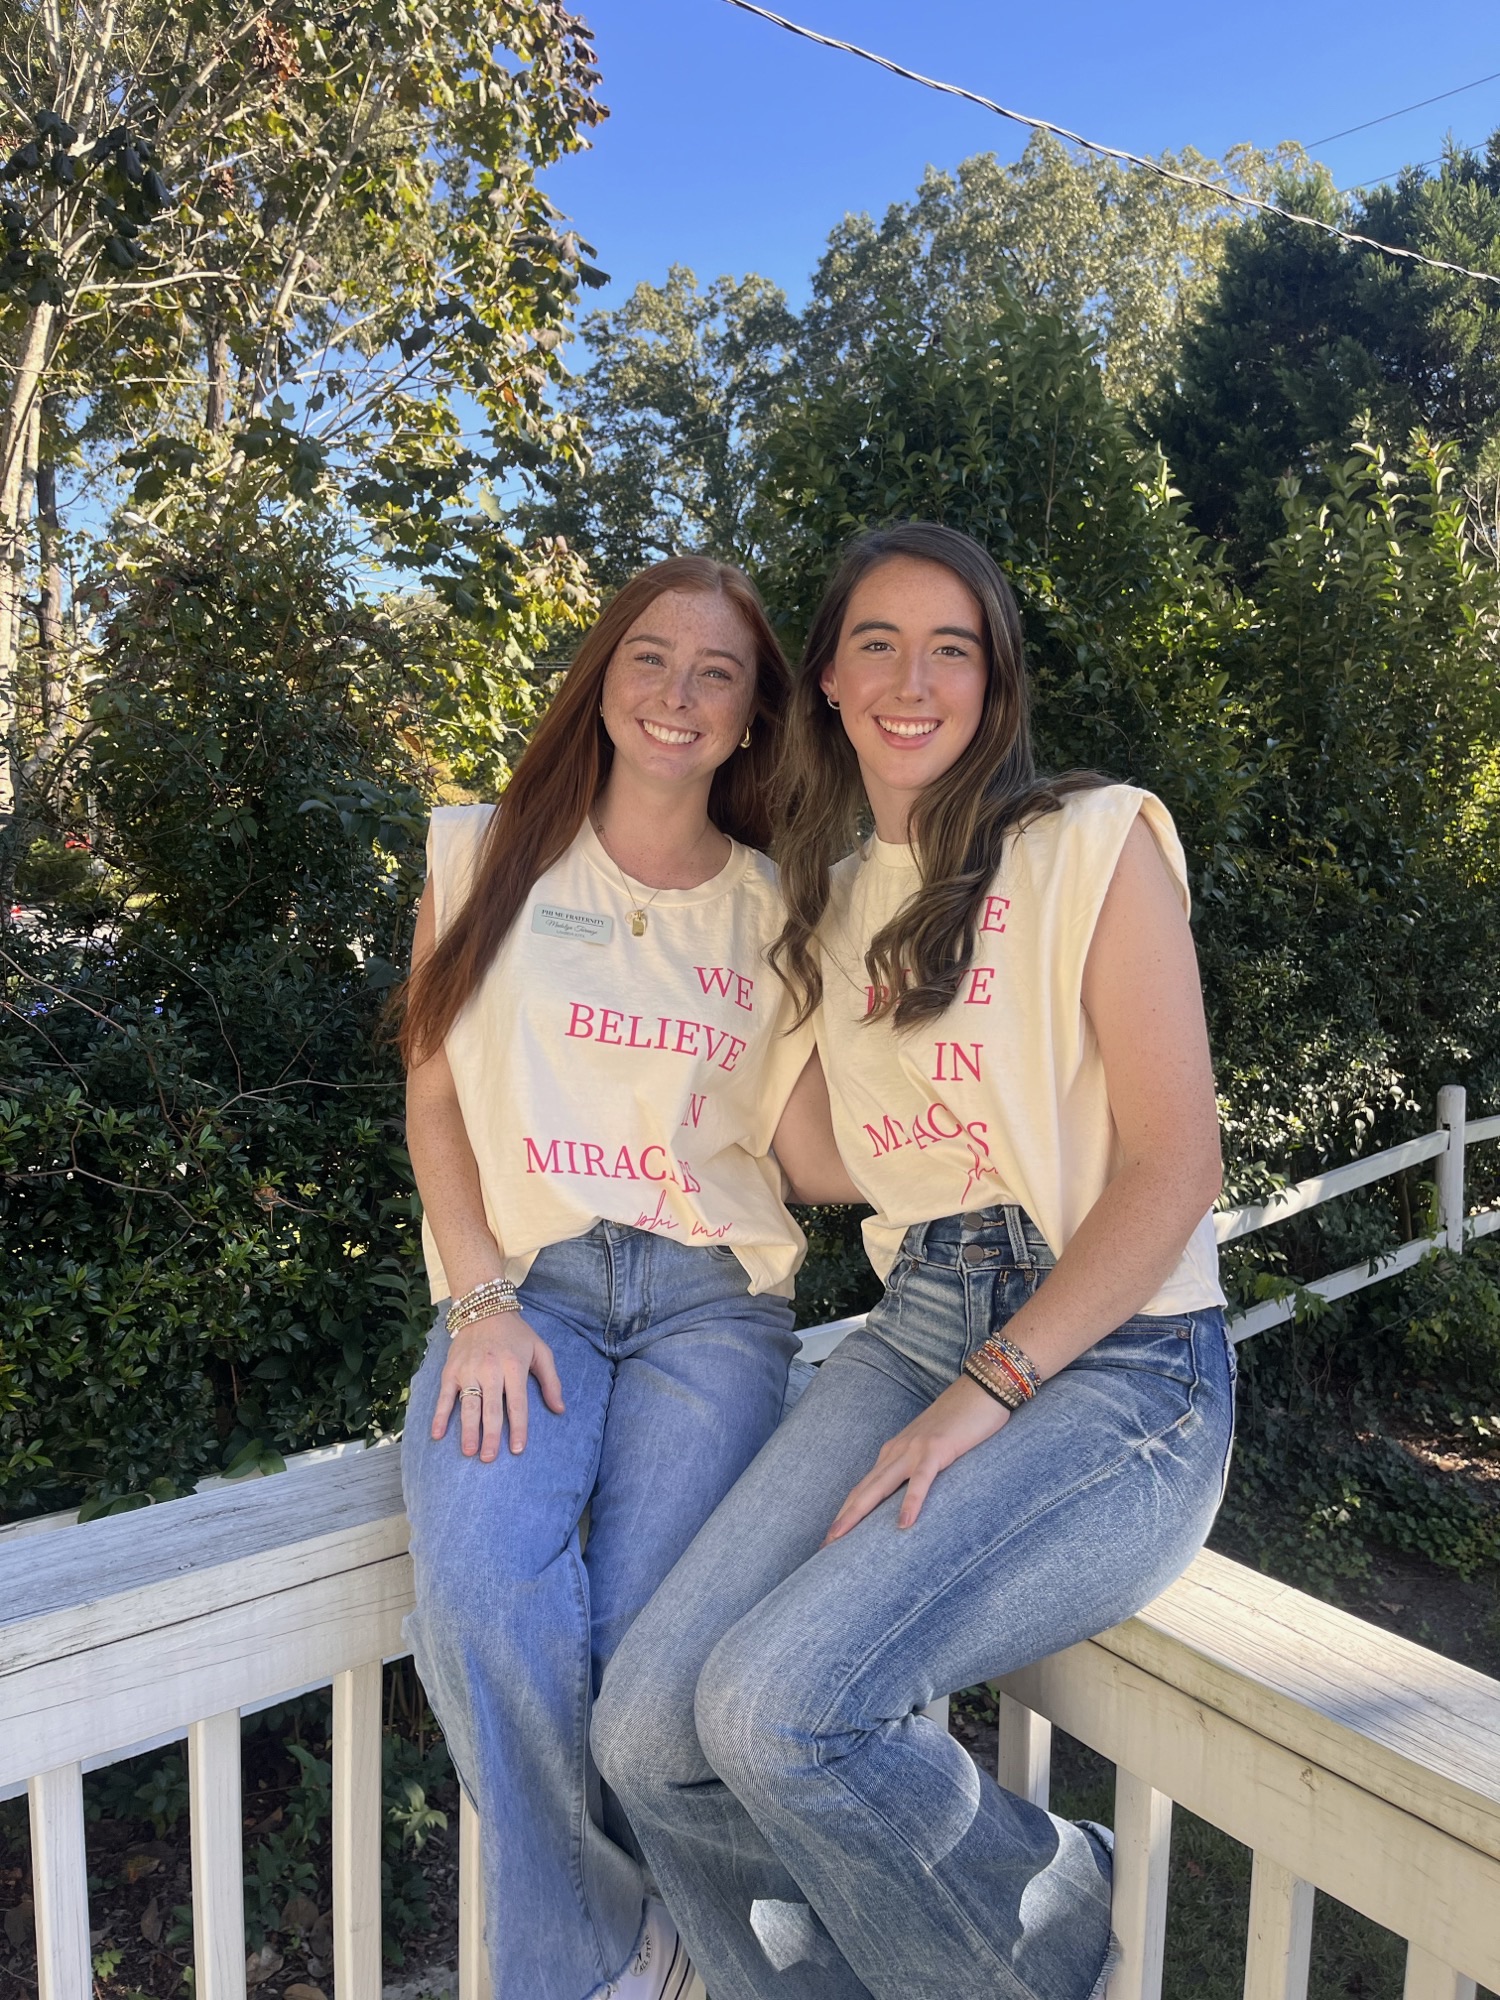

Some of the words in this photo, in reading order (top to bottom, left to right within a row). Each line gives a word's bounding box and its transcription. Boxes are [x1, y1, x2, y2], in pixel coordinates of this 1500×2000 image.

[565, 913, 605, 926] FRATERNITY
[979, 895, 1011, 933] E
[693, 966, 754, 1011] WE
[564, 1002, 747, 1072] BELIEVE
[931, 1042, 984, 1083] IN
[681, 1093, 707, 1128] N
